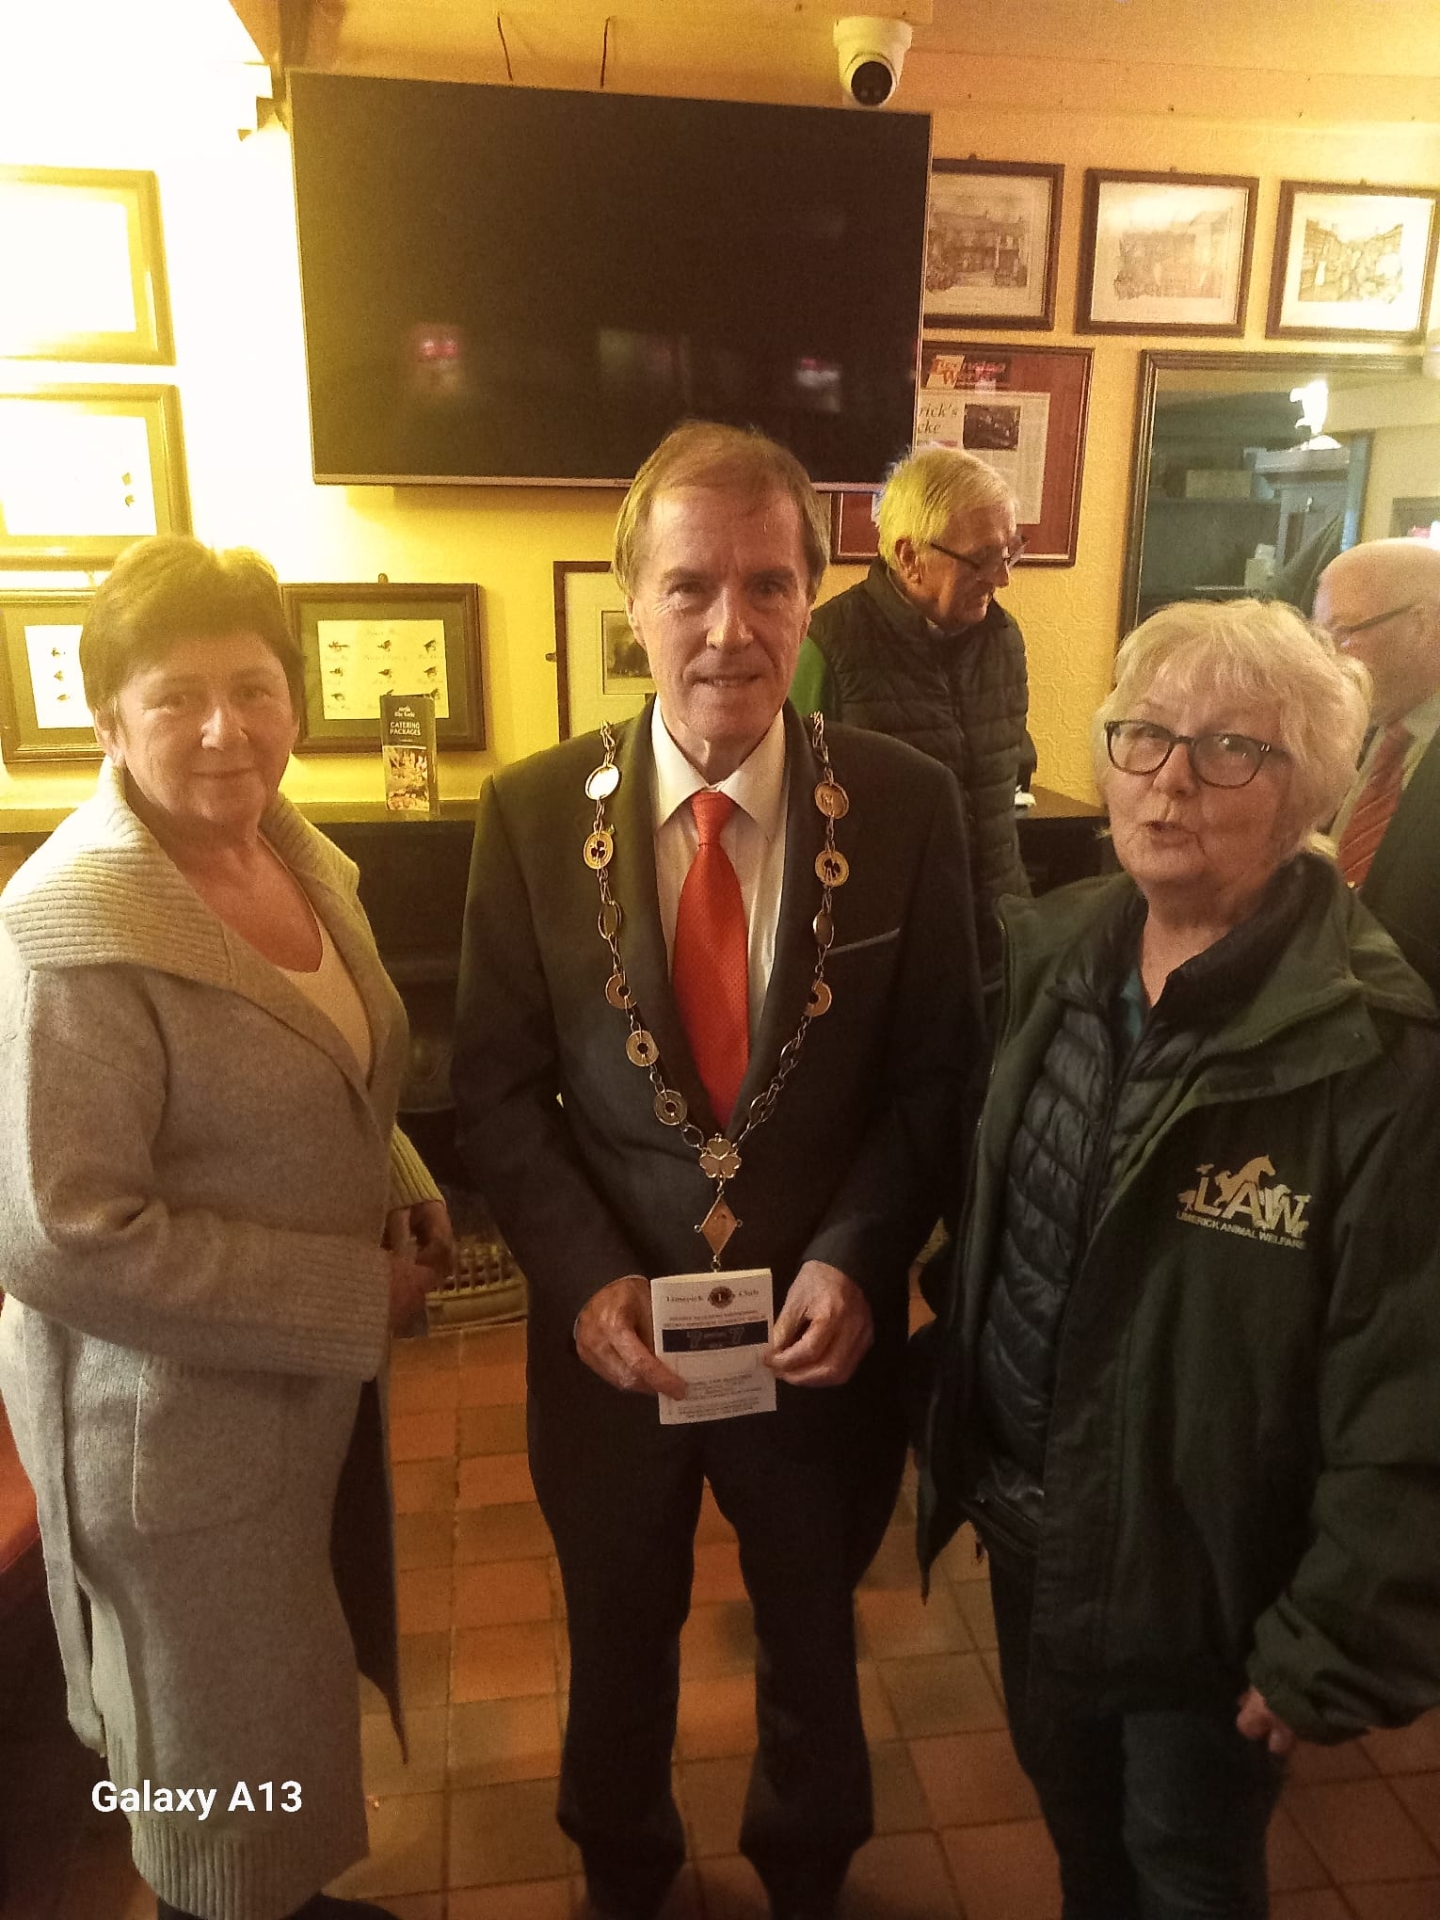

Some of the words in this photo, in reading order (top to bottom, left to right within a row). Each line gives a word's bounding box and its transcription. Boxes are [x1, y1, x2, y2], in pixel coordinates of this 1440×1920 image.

[390, 721, 420, 729] CATERING
[390, 728, 421, 736] PACKAGES
[1194, 1177, 1311, 1236] LAW
[1220, 1222, 1258, 1239] ANIMAL
